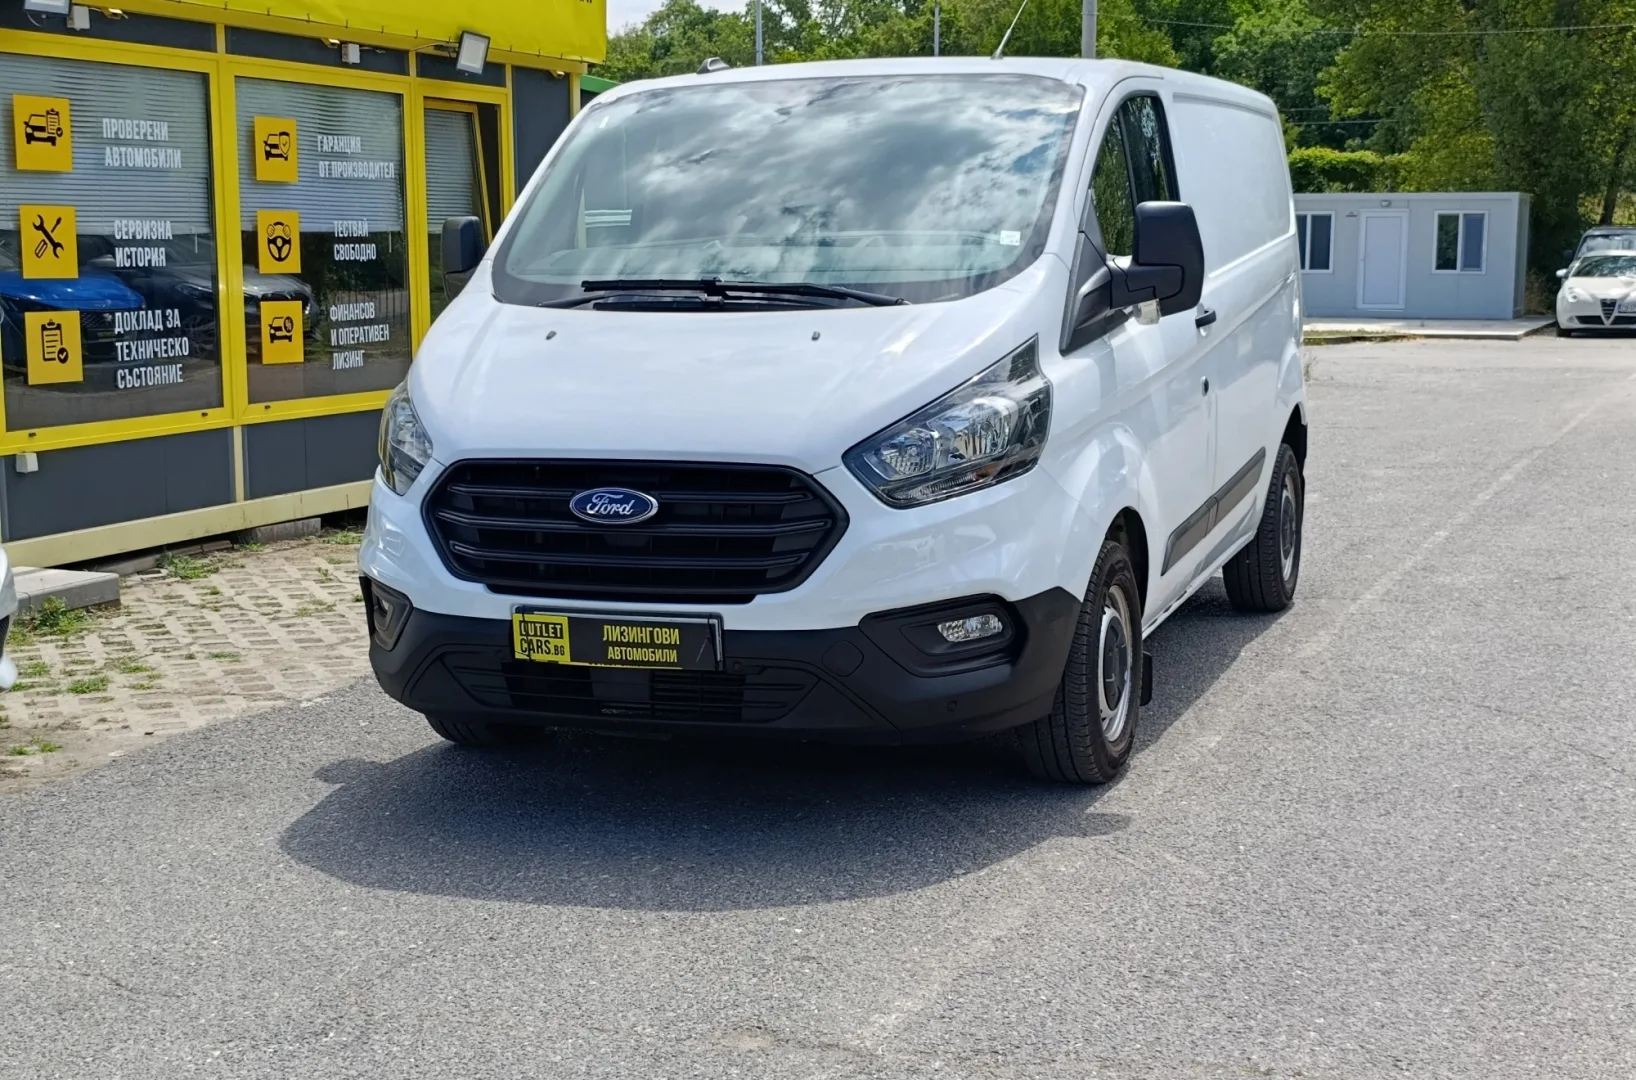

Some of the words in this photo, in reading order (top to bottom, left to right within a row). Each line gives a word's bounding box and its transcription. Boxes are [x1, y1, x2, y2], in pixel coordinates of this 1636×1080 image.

[103, 118, 168, 141] ПРОВЕРЕНИ
[317, 135, 361, 155] ГАРАНЦИЯ
[105, 146, 181, 168] АВТОМОБИЛИ
[319, 160, 329, 178] ОТ
[331, 161, 395, 180] ПРОИЗВОДИТЕЛ
[113, 219, 173, 240] СЕРВИЗНА
[333, 218, 368, 238] ТЕСТВАЙ
[115, 247, 166, 267] ИСТОРИЯ
[333, 243, 376, 262] СВОБОДНО
[114, 309, 163, 335] ДОКЛАД
[166, 308, 181, 329] ЗА
[329, 301, 376, 322] ФИНАНСОВ
[330, 329, 337, 346] И
[338, 324, 390, 345] ОПЕРАТИВЕН
[115, 337, 189, 362] ТЕХНИЧЕСКО
[332, 350, 364, 370] ЛИЗИНГ
[117, 364, 183, 389] СЪСТОЯНИЕ
[586, 493, 636, 515] Ford
[602, 624, 680, 645] ЛИЗИНГОВИ
[607, 646, 678, 663] АВТОМОБИЛИ
